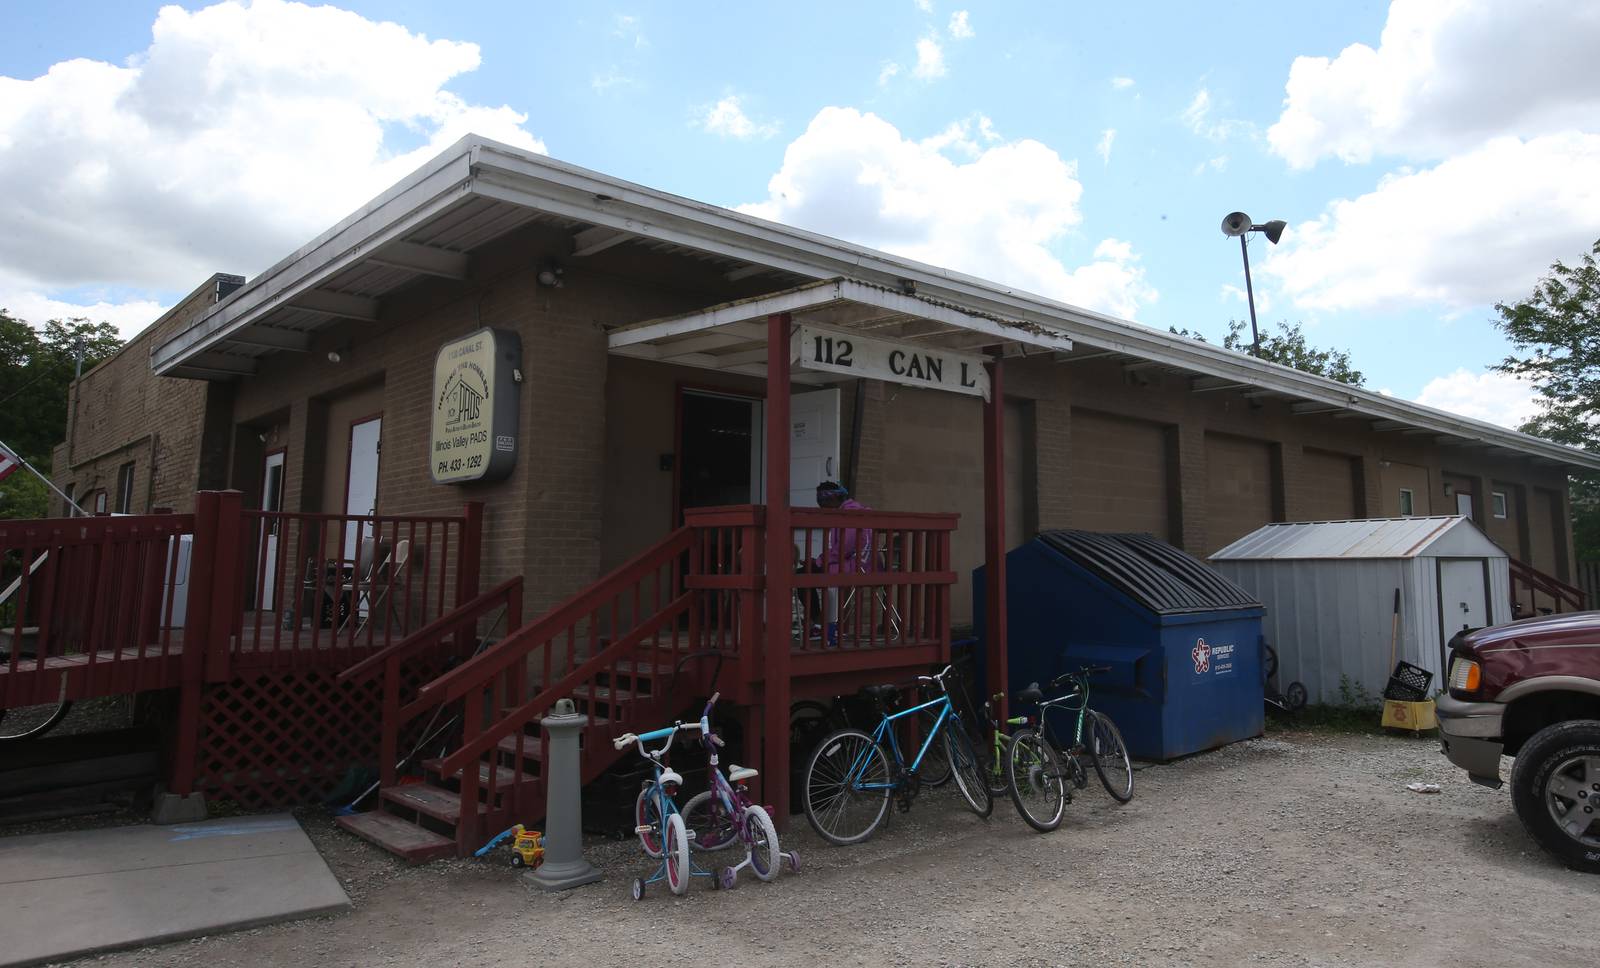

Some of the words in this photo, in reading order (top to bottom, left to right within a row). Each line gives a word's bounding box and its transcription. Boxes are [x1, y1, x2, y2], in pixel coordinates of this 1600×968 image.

[813, 335, 853, 367] 112
[888, 350, 943, 383] CAN
[960, 362, 976, 388] L
[469, 361, 489, 400] HOMELESS
[459, 382, 481, 421] PADS
[453, 435, 469, 449] Valley
[470, 430, 487, 445] PADS
[450, 458, 462, 472] 433
[467, 454, 482, 469] 1292
[1211, 644, 1235, 656] REPUBLIC
